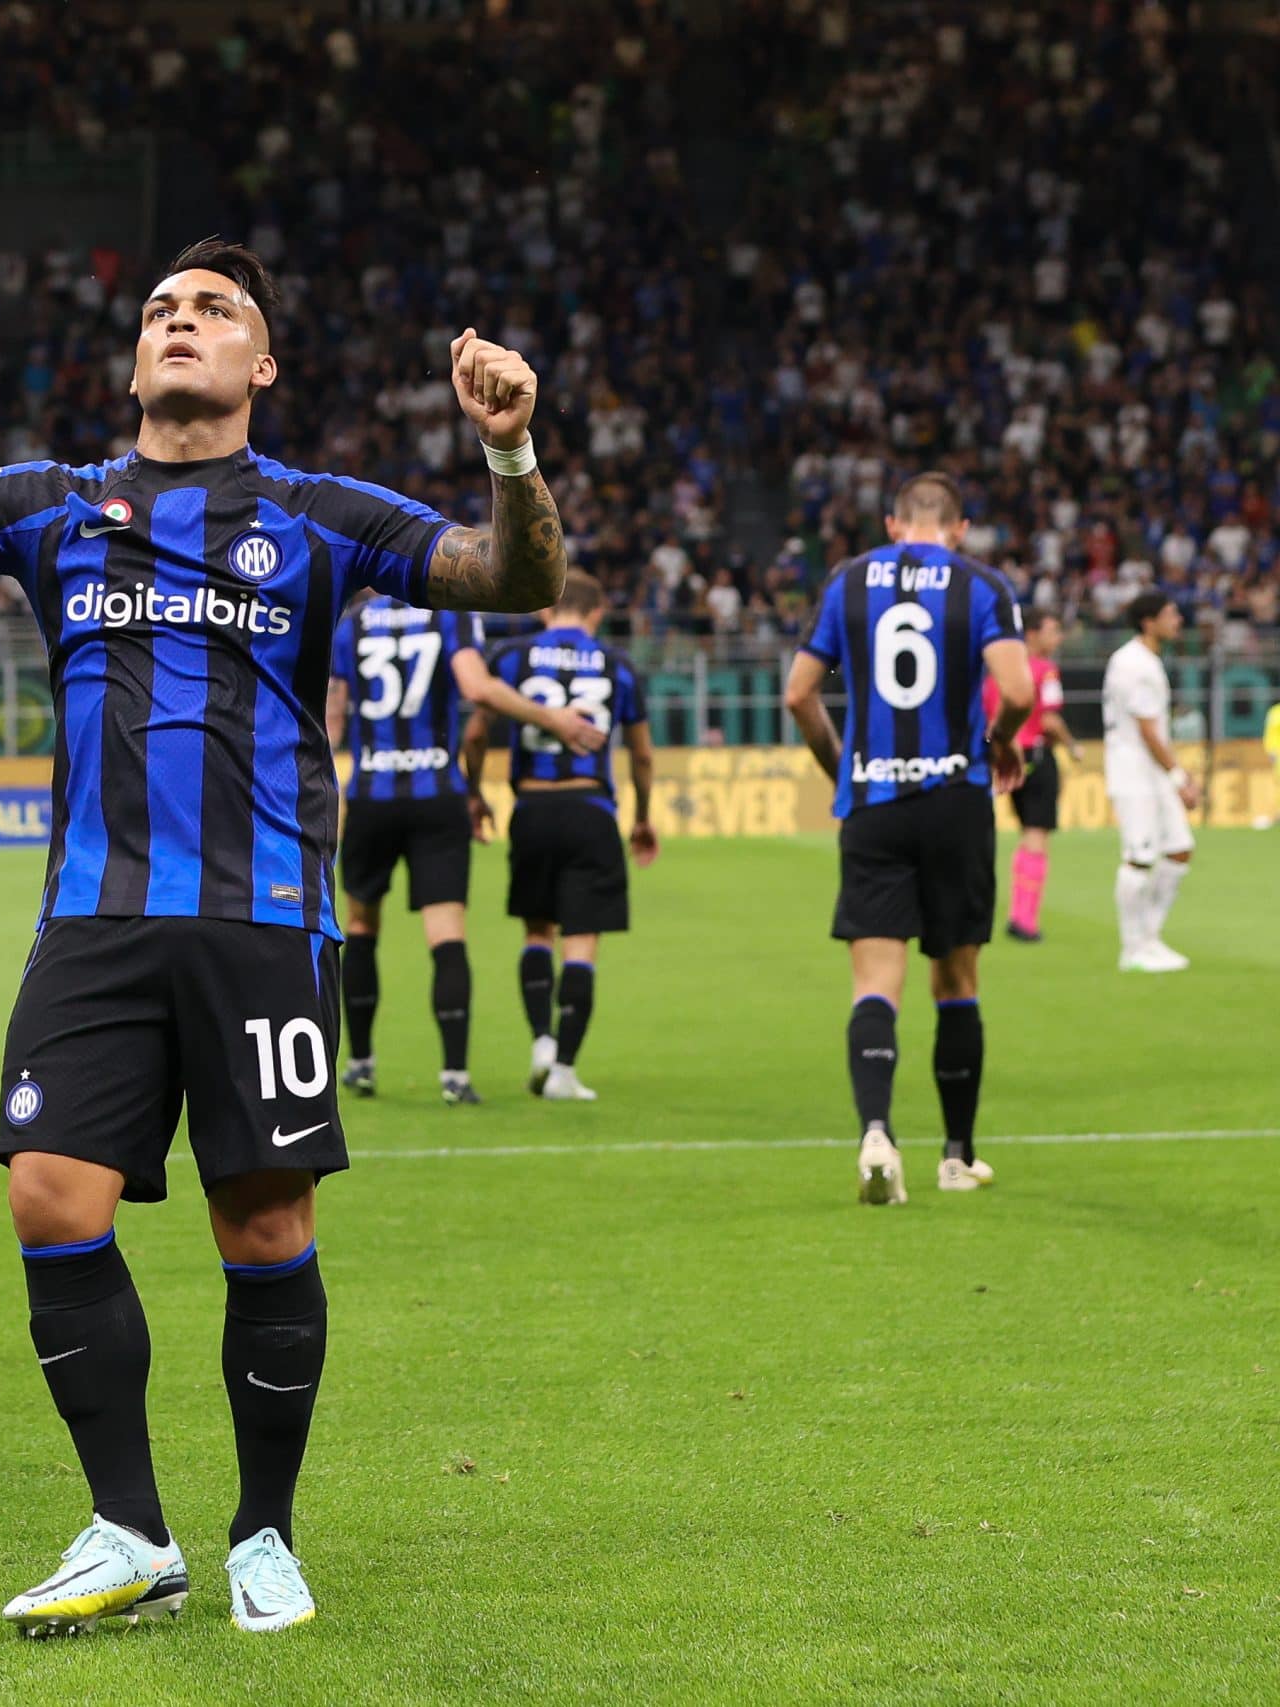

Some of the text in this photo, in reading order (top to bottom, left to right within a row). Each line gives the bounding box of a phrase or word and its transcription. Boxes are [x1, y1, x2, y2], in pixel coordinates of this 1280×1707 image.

[866, 560, 898, 588] DE
[66, 582, 292, 635] digitalbits
[357, 631, 442, 720] 37
[874, 602, 937, 710] 6
[519, 675, 612, 755] 23
[359, 744, 450, 773] Lenovo
[851, 751, 968, 784] Lenovo
[244, 1017, 329, 1100] 10
